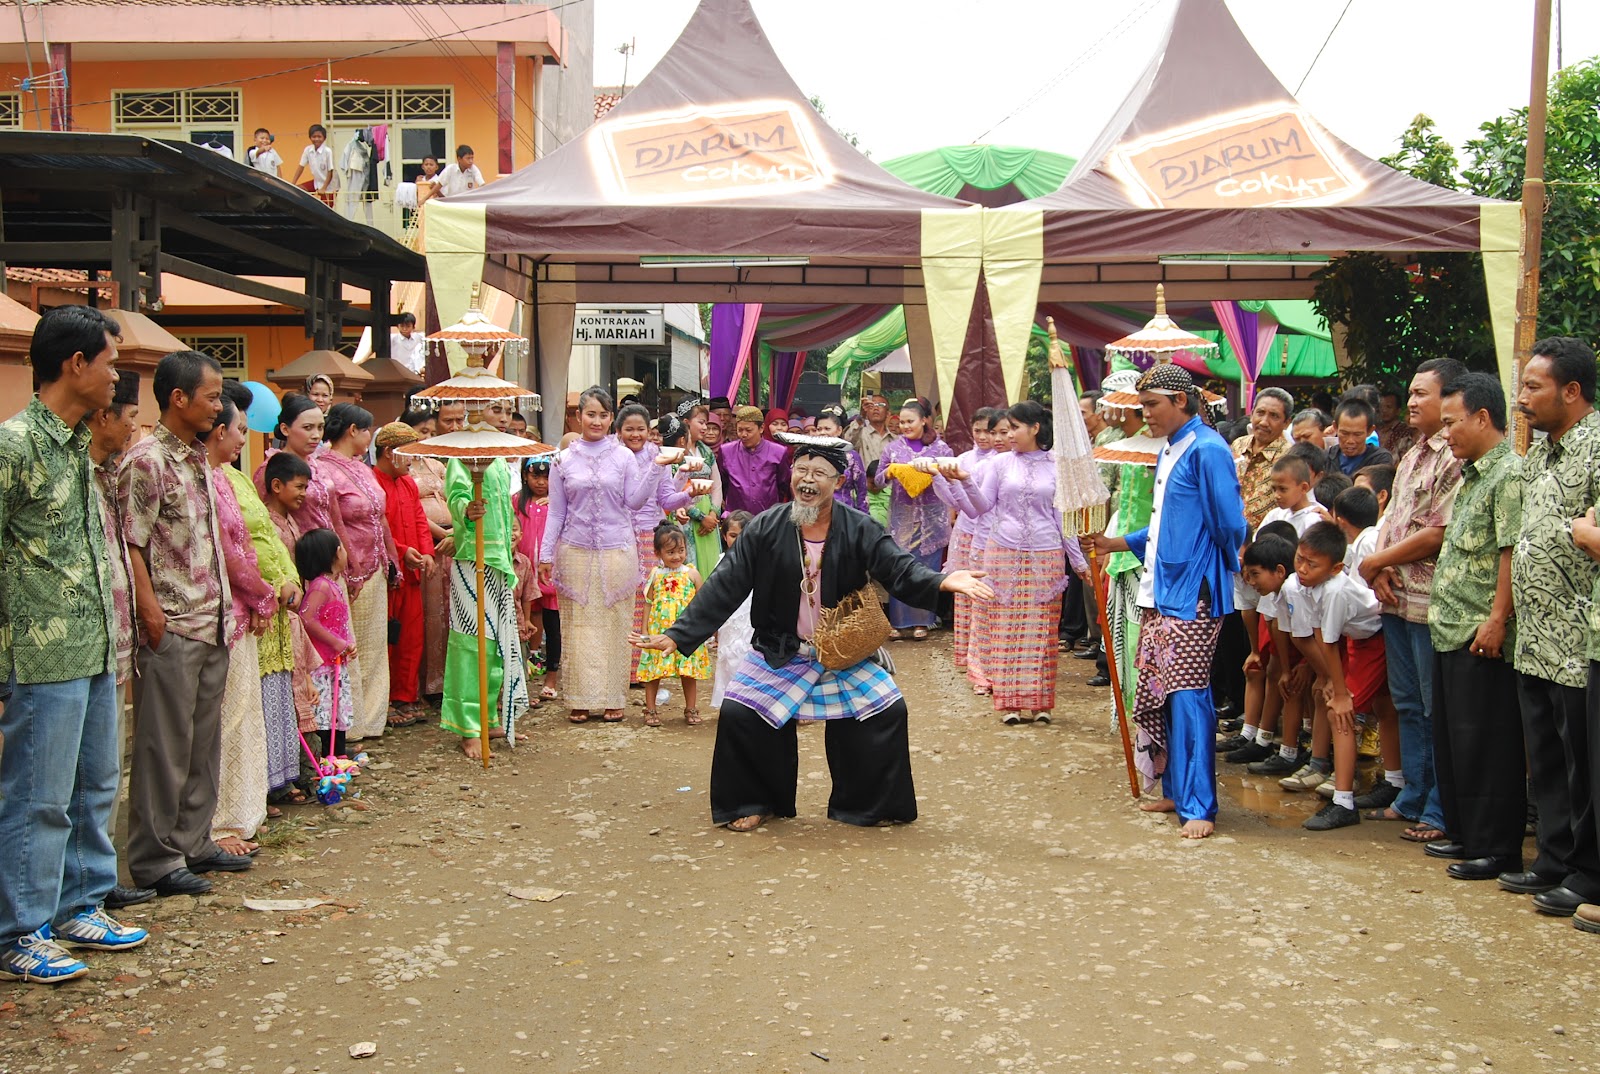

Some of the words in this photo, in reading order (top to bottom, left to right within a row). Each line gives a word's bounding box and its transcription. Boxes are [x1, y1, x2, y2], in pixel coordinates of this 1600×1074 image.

[635, 125, 785, 169] DJARUM
[1160, 128, 1302, 190] DJARUM
[1214, 171, 1336, 197] COKLAT
[576, 328, 592, 341] Hj.
[595, 328, 647, 340] MARIAH
[650, 328, 655, 340] 1
[580, 317, 645, 326] KONTRAKAN
